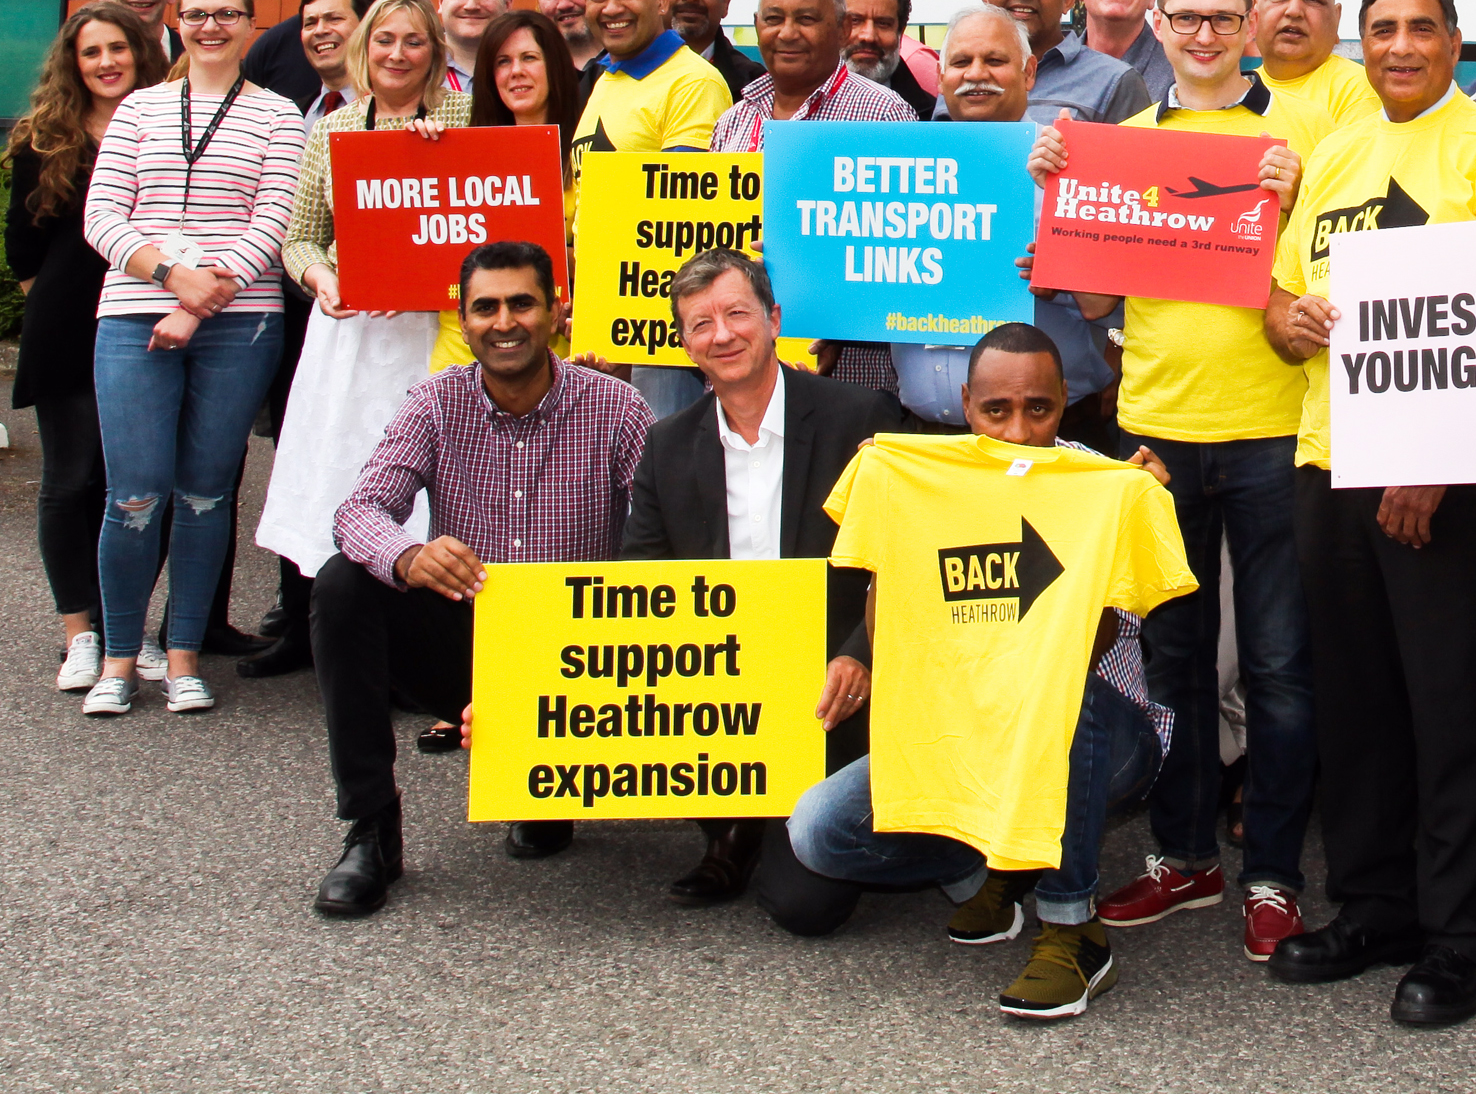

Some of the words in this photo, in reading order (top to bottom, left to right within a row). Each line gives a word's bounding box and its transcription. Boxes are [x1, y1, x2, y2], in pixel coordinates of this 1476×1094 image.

[356, 177, 440, 210] MORE
[449, 174, 540, 208] LOCAL
[642, 163, 718, 200] Time
[729, 164, 761, 201] to
[833, 156, 960, 195] BETTER
[1058, 177, 1160, 207] Unite4
[411, 213, 488, 245] JOBS
[796, 200, 998, 241] TRANSPORT
[1054, 197, 1215, 232] Heathrow
[1230, 222, 1263, 235] unite
[636, 215, 763, 257] support
[1051, 226, 1100, 242] Working
[1103, 232, 1143, 244] people
[1147, 237, 1176, 248] need
[1192, 239, 1211, 250] 3rd
[1215, 243, 1260, 256] runway
[845, 245, 944, 285] LINKS
[885, 312, 1025, 334] #backheathr
[1341, 346, 1476, 395] YOUNG
[943, 551, 1021, 594] BACK
[565, 575, 677, 619] Time
[691, 574, 736, 618] to
[951, 603, 1017, 625] HEATHROW
[560, 633, 741, 687] support
[537, 693, 762, 739] Heathrow
[528, 753, 767, 807] expansion
